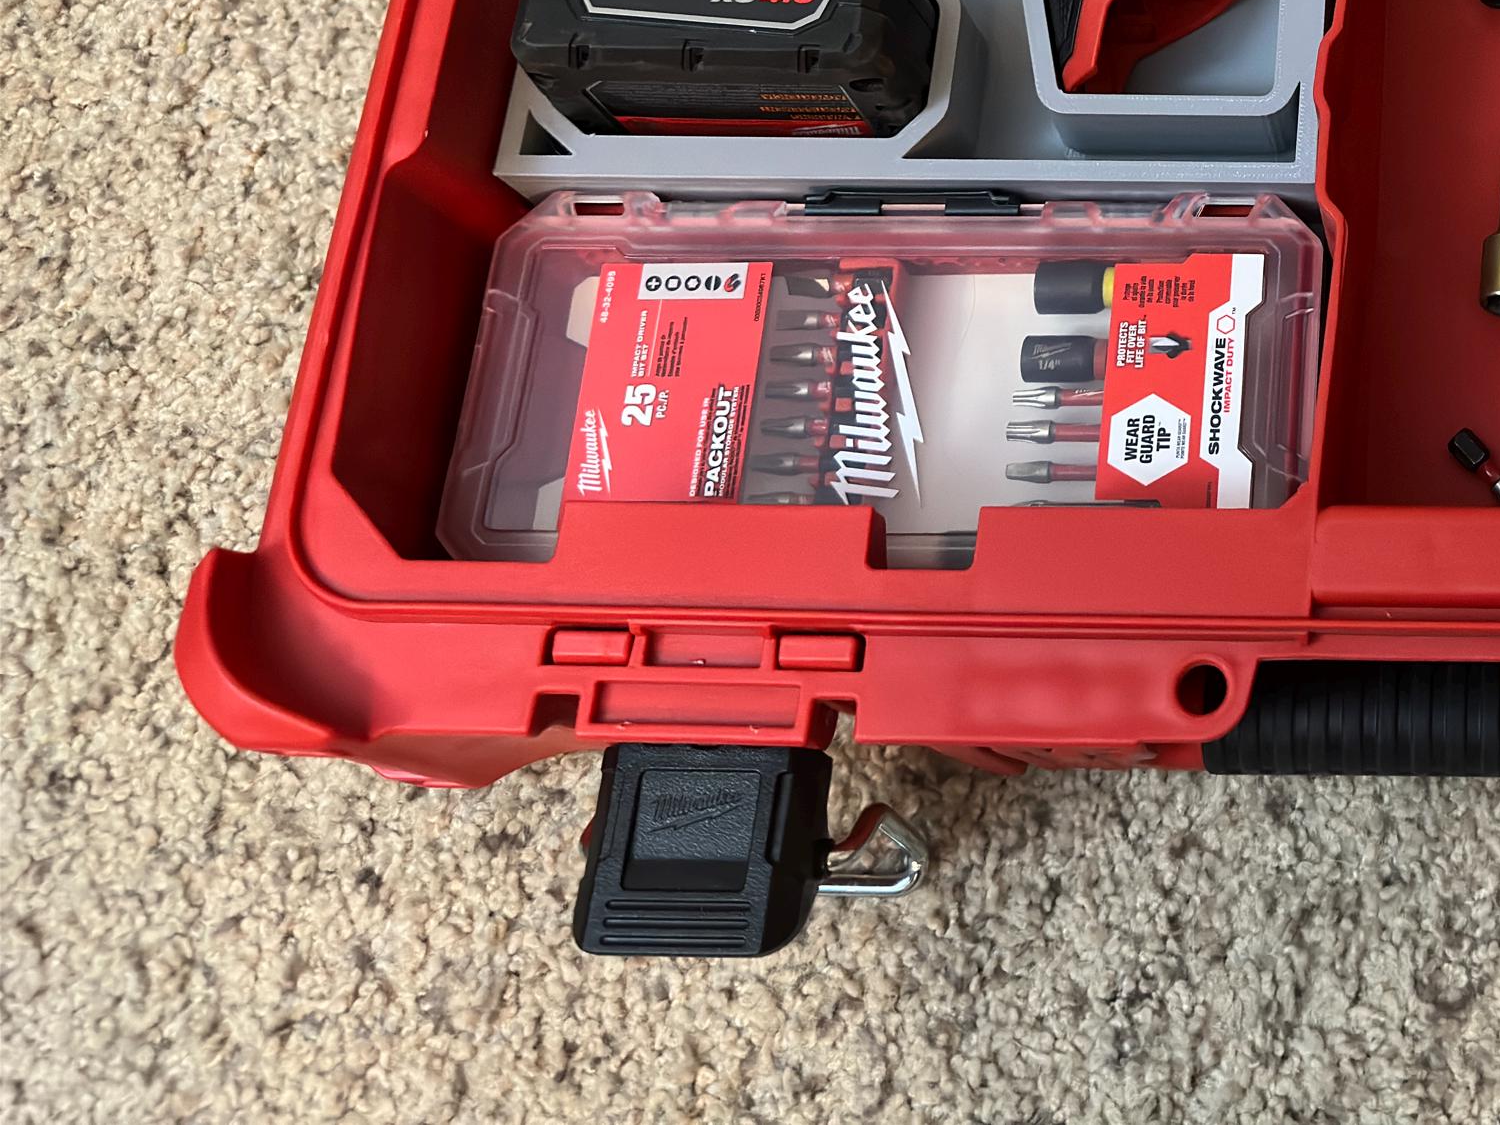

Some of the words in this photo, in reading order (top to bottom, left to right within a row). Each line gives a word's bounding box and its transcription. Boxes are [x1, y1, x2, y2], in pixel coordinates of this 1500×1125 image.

[636, 310, 648, 343] DRIVER
[1127, 325, 1138, 348] OVER
[1136, 336, 1146, 348] OF
[641, 344, 650, 359] SET
[1116, 321, 1129, 367] PROTECTS
[1126, 349, 1136, 364] FIT
[1135, 349, 1146, 368] LIFE
[1226, 337, 1236, 367] DUTY
[631, 345, 643, 378] IMPACT
[639, 360, 648, 378] BIT
[621, 384, 658, 427] 25
[701, 397, 710, 407] IN
[729, 386, 740, 417] SYSTEM
[829, 283, 899, 505] Milwaukee
[1208, 337, 1227, 455] SHOCKWAVE
[1223, 369, 1235, 413] IMPACT
[698, 409, 708, 428] USE
[577, 408, 602, 497] Milwaukee
[695, 429, 705, 448] FOR
[704, 386, 733, 497] PACKOUT
[722, 419, 734, 456] STORAGE
[1124, 418, 1140, 461] WEAR
[1139, 414, 1155, 464] GUARD
[1156, 426, 1172, 452] TIP
[690, 449, 702, 498] DESIGNED
[718, 458, 729, 498] MODULAR
